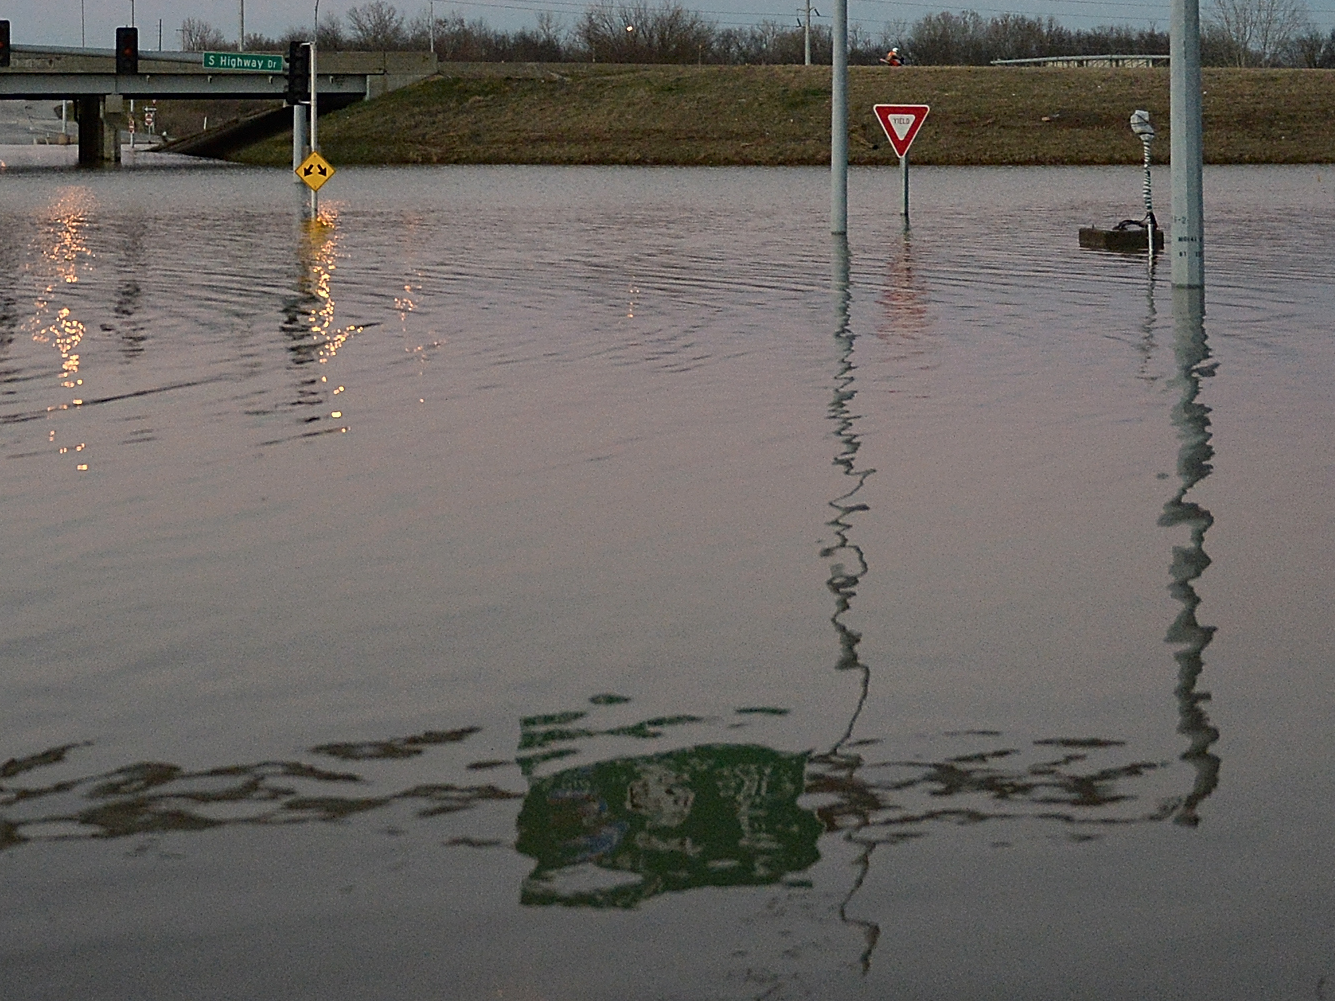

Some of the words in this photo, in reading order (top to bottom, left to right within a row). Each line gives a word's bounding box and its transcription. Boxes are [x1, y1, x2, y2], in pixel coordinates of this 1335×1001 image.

[208, 55, 215, 66] S
[220, 56, 264, 69] Highway
[267, 59, 277, 68] Dr
